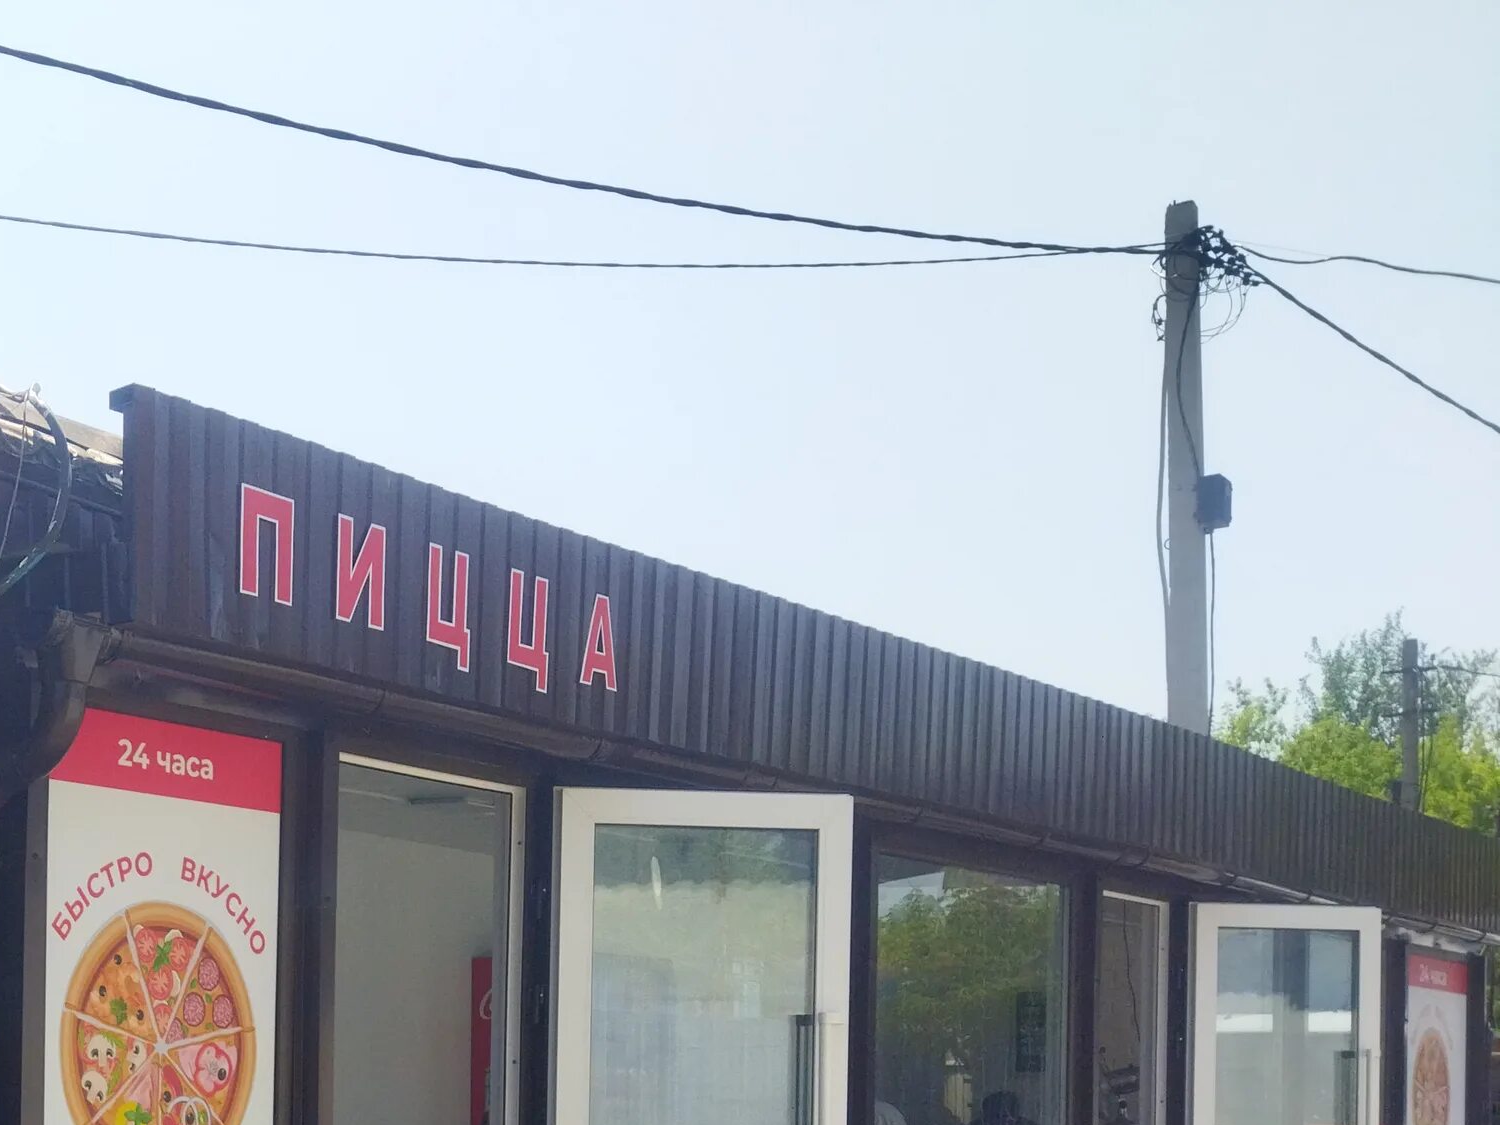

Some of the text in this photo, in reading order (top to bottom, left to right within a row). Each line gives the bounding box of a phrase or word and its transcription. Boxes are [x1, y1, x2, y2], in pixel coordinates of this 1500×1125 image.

[239, 482, 618, 694] ПИЦЦА
[117, 738, 215, 781] 24 часа
[51, 851, 267, 957] БЫСТРО ВКУСНО
